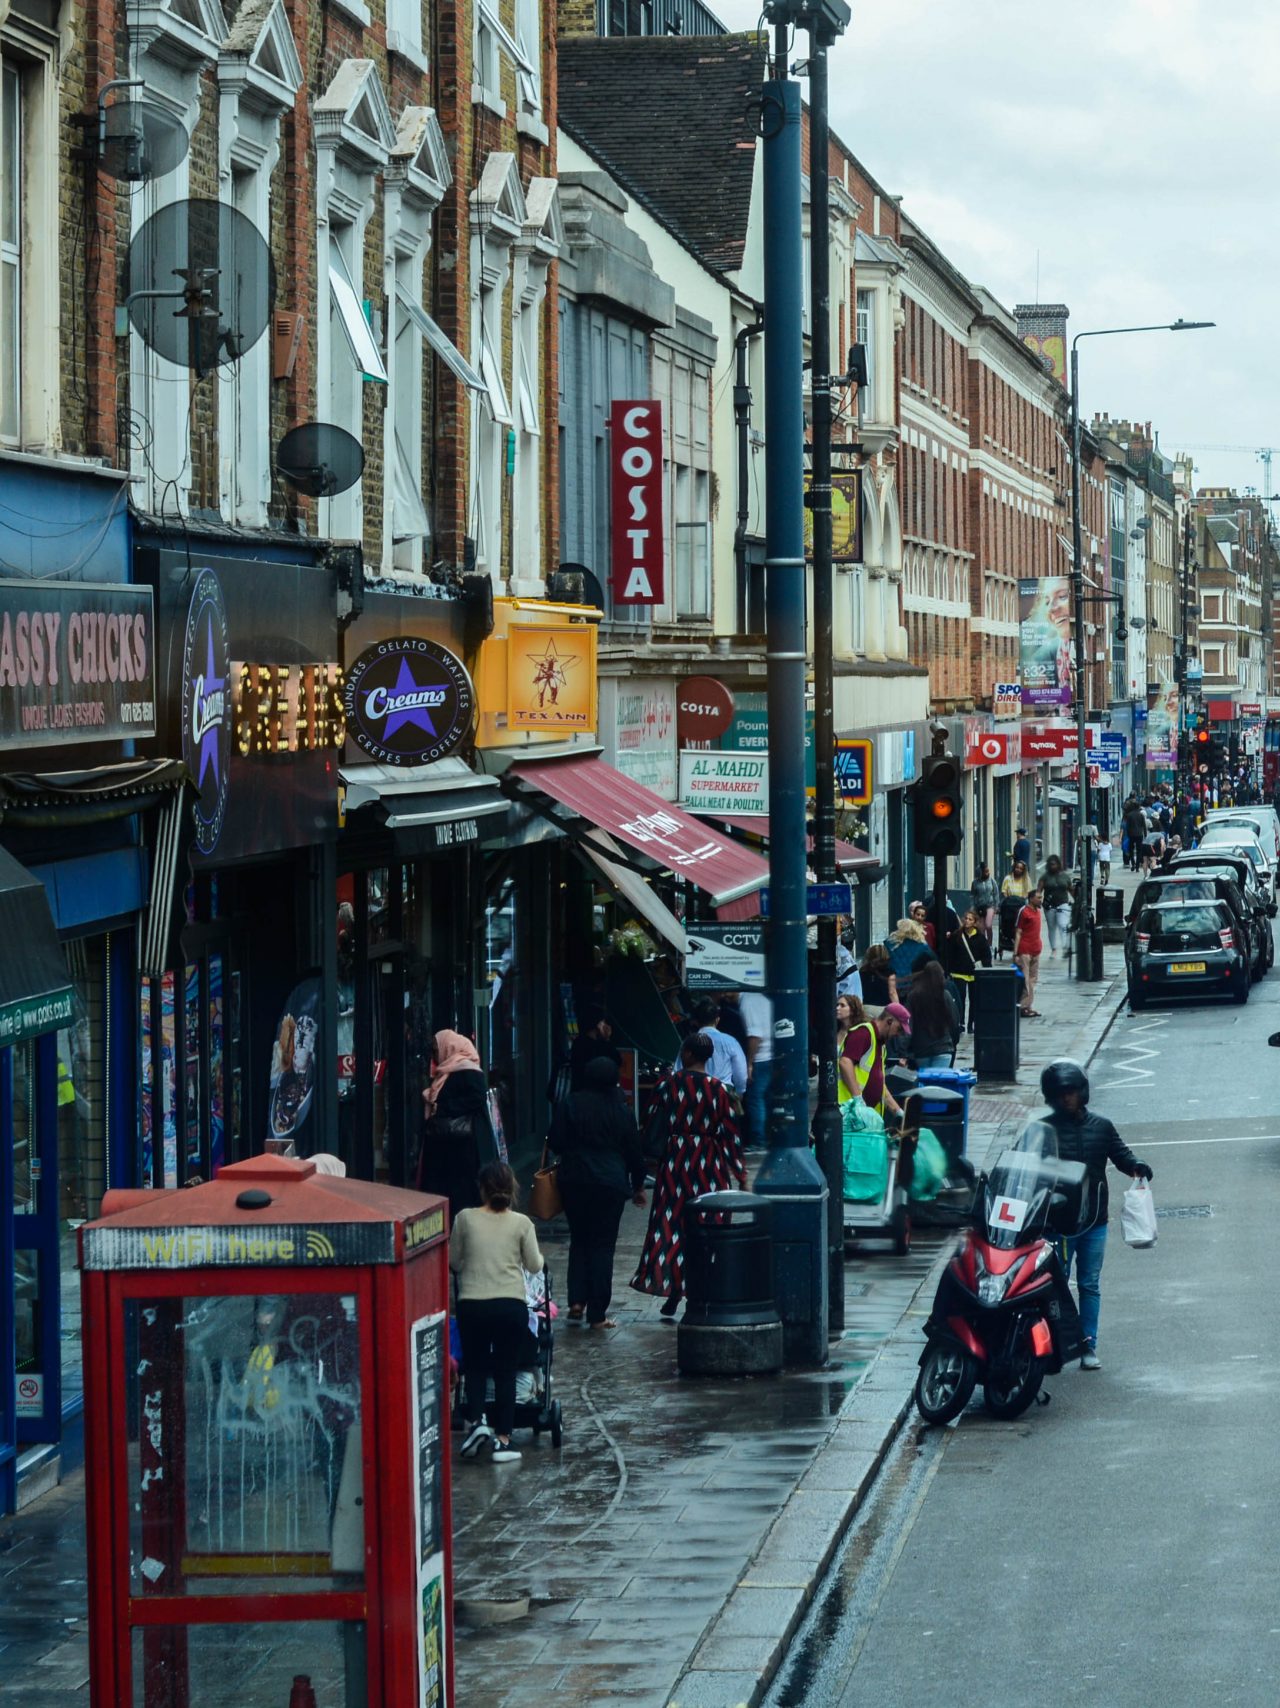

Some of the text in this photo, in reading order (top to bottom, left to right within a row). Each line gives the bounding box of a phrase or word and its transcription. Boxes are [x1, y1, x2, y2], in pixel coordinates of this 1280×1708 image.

[622, 406, 653, 598] COSTA
[68, 611, 146, 684] CHICKS
[378, 640, 428, 655] GELATO
[346, 661, 367, 717] SUNDAES
[442, 654, 469, 709] WAFFLES
[997, 684, 1021, 694] SPO
[365, 686, 446, 721] Creams
[680, 702, 720, 716] COSTA
[357, 734, 401, 765] CREPES
[421, 726, 462, 763] COFFEE
[691, 760, 766, 778] AL-MAHDI
[690, 780, 760, 793] SUPERMARKET
[834, 778, 862, 790] LDI
[708, 796, 726, 810] MEAT
[732, 798, 764, 811] POULTRY
[722, 934, 762, 946] CCTV
[999, 1203, 1016, 1222] L
[144, 1233, 295, 1263] WiFi here
